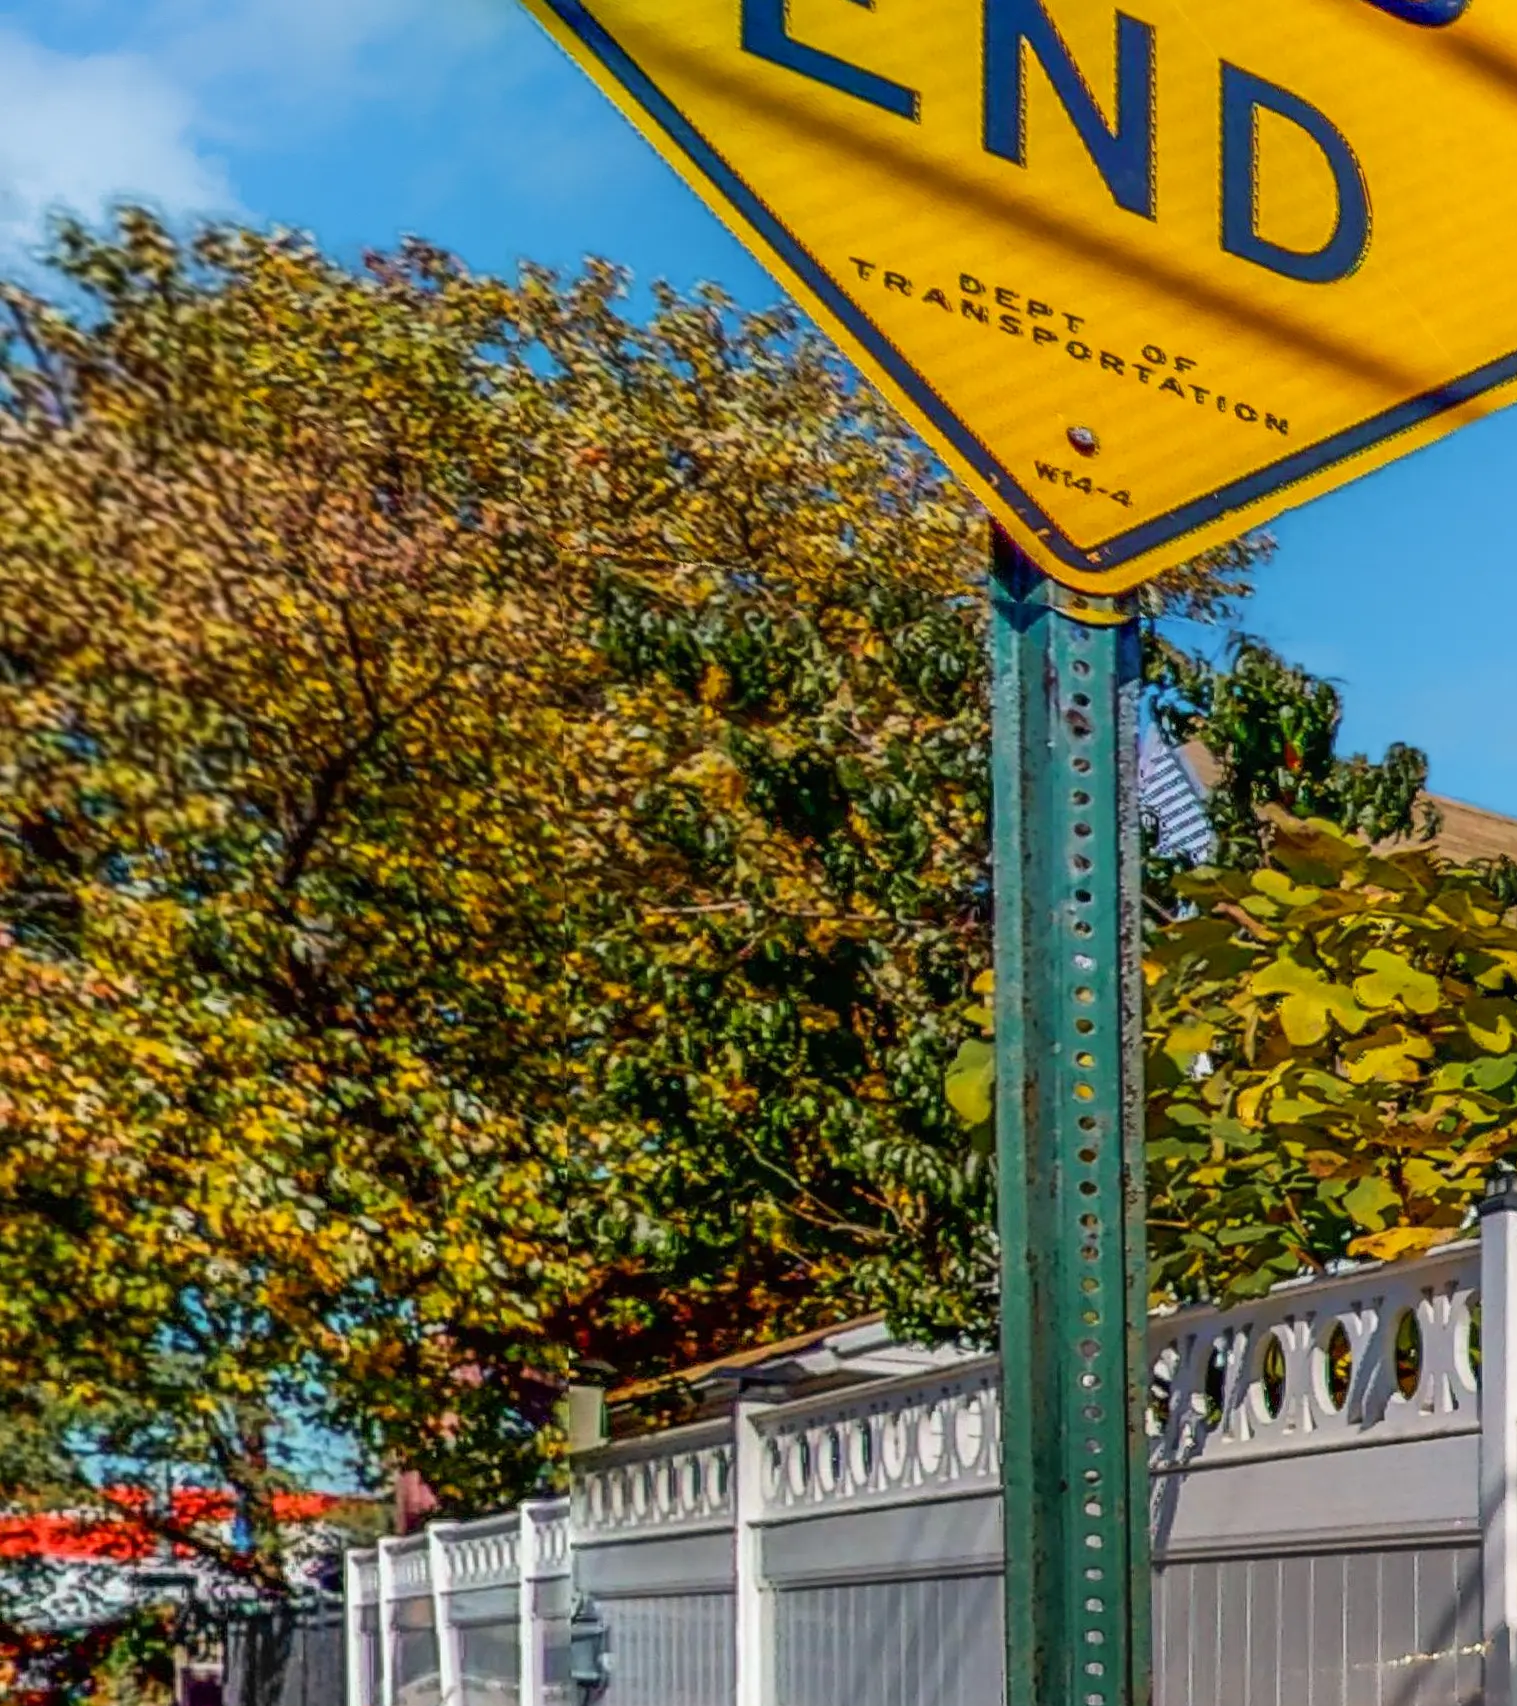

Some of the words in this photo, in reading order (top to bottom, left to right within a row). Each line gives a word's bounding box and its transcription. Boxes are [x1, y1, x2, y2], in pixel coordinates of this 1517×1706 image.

[849, 256, 1289, 436] TRANSPORTATION
[959, 273, 1085, 334] DEPT
[1141, 343, 1197, 373] OF
[1034, 459, 1133, 507] W14-4
